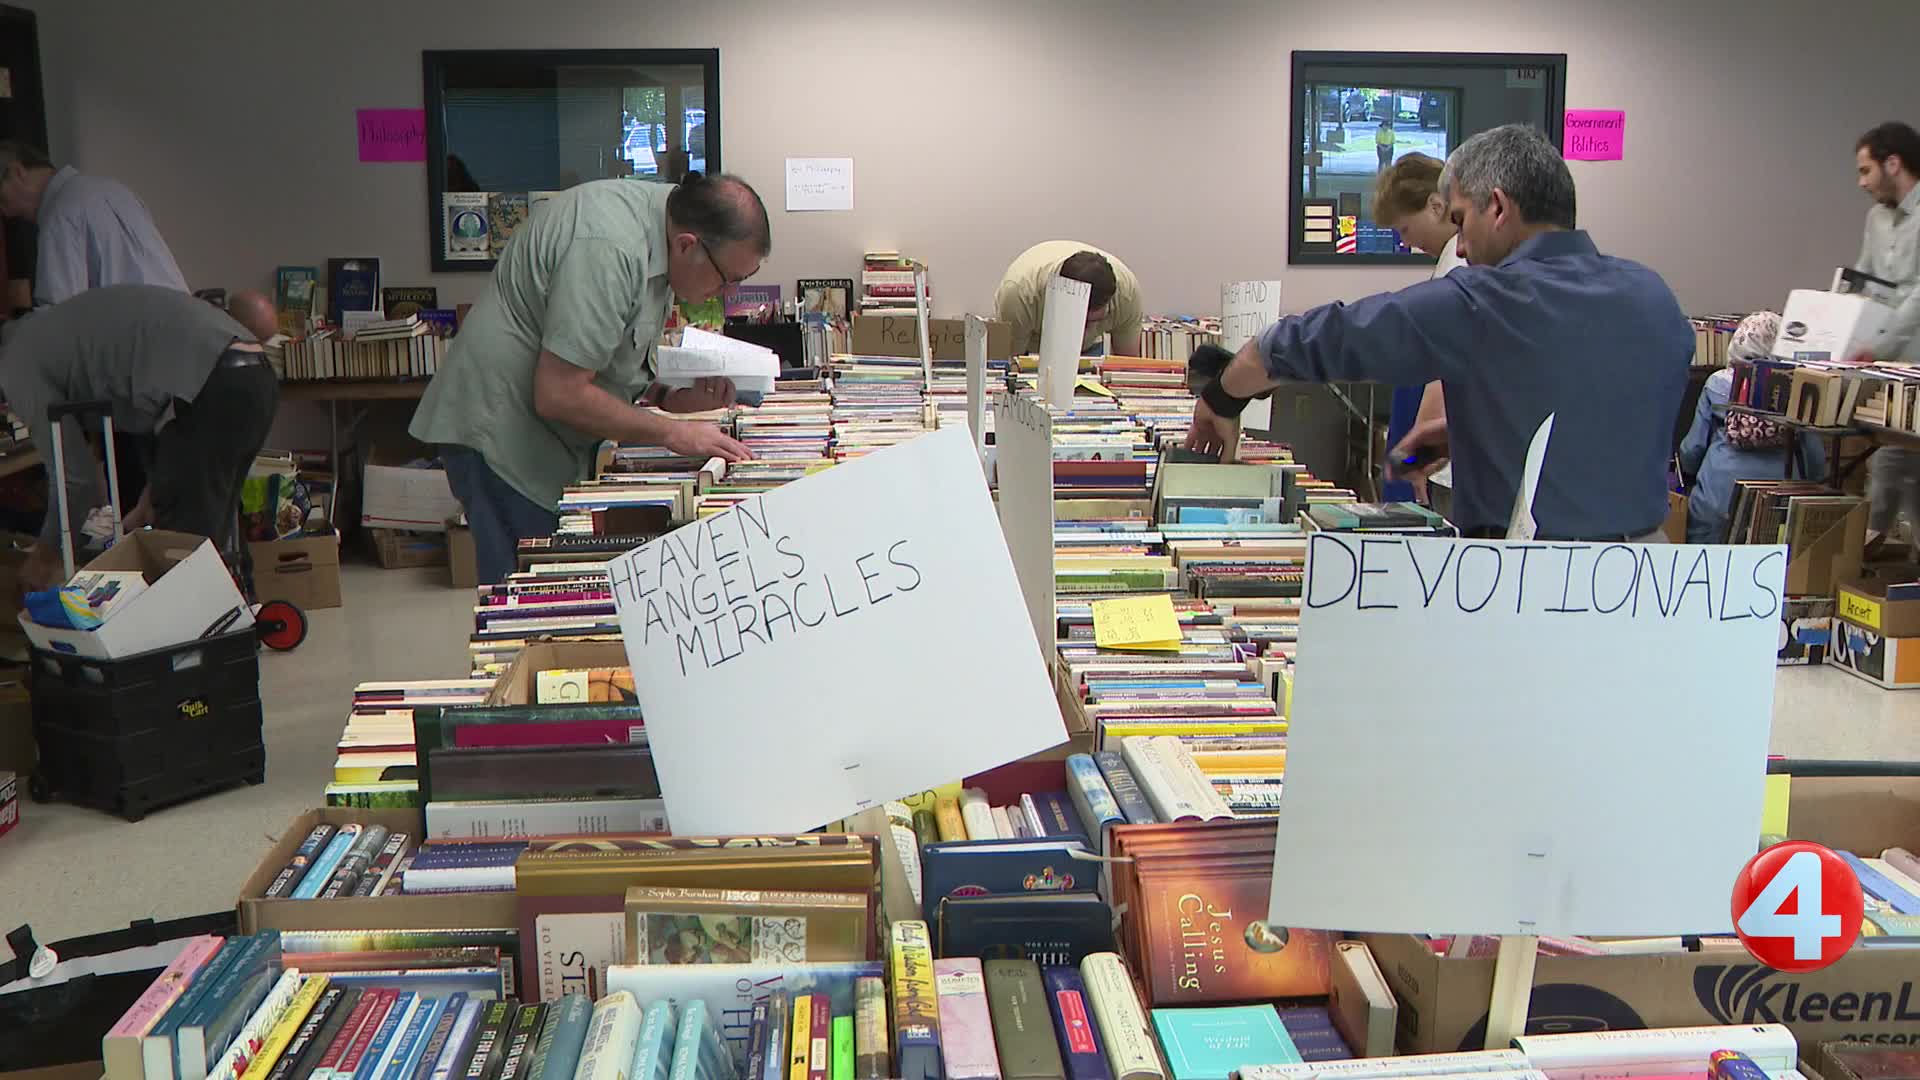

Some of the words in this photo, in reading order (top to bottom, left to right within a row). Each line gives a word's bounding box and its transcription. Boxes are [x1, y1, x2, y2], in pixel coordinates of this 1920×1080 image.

[1565, 113, 1625, 130] Government
[1571, 133, 1609, 153] Politics
[1244, 281, 1267, 303] AND
[881, 316, 966, 353] Relgio
[561, 536, 647, 546] CHRISTIANITY
[609, 496, 773, 607] HEAVEN
[645, 535, 804, 644] ANGELS
[1307, 540, 1785, 621] DEVOTIONALS
[674, 539, 921, 677] MIRACLES
[182, 700, 203, 713] Quik
[190, 704, 209, 718] Cart
[1177, 893, 1207, 991] Calling
[1207, 904, 1232, 974] Jesus
[1027, 953, 1070, 965] THE
